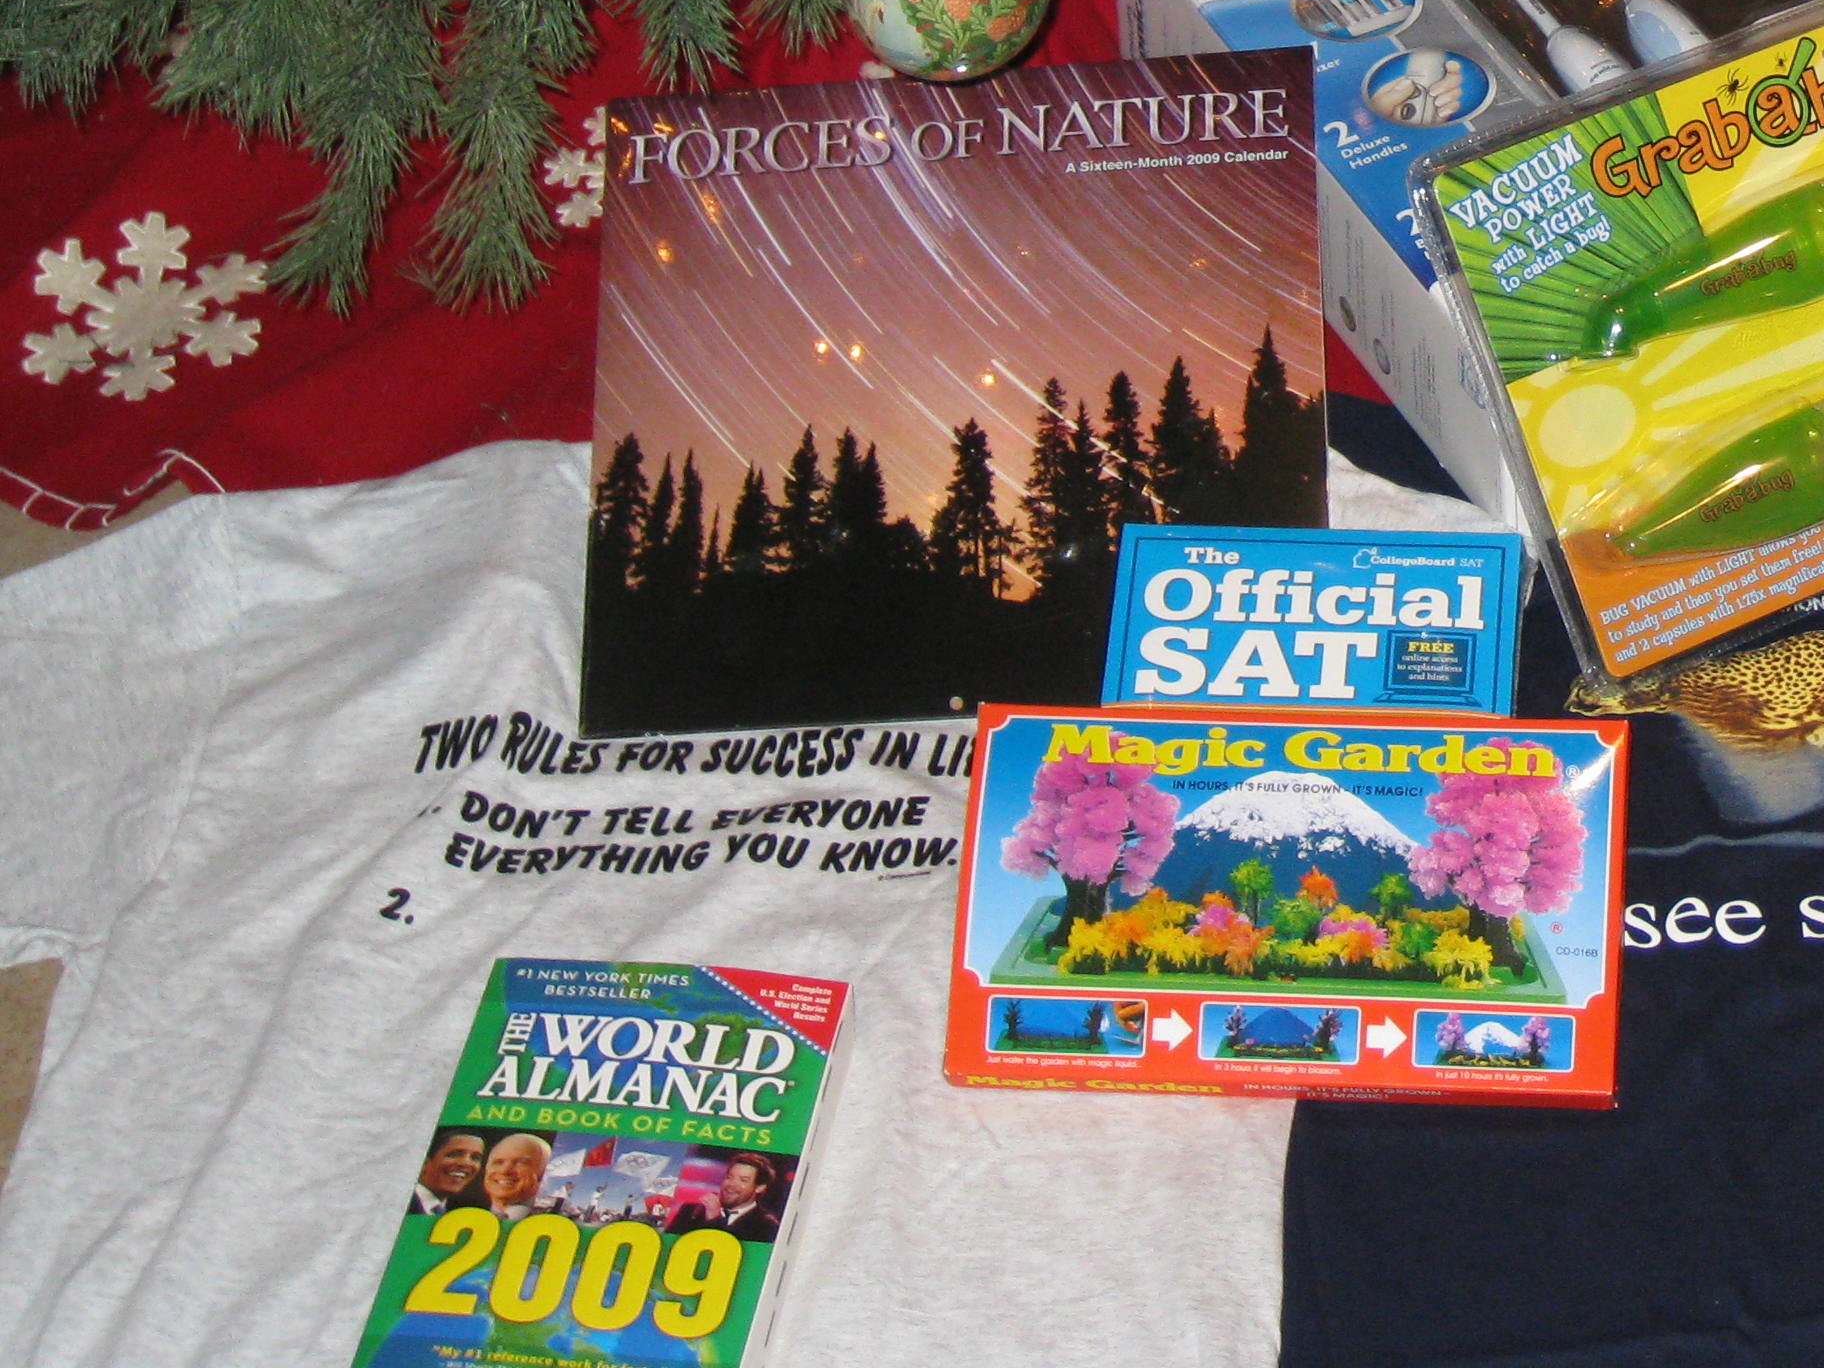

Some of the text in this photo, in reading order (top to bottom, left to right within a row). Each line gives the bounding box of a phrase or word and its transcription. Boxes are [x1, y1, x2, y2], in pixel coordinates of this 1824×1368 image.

[628, 87, 1291, 186] FORCES OF NATURE
[1323, 121, 1359, 148] 2
[1341, 134, 1391, 160] Deluxe
[1064, 148, 1289, 174] A Sixteen-Month 2009 Calendar
[1349, 142, 1408, 170] Handles
[1448, 132, 1586, 231] VACUUM
[1483, 170, 1577, 248] POWER
[1491, 245, 1527, 281] with
[1528, 189, 1598, 252] LIGHT
[1500, 215, 1614, 296] to catch a bug!
[1183, 546, 1485, 568] The CollegeBoard SAT
[1143, 568, 1485, 631] Official
[1600, 602, 1630, 625] BUG
[1631, 577, 1687, 612] VACUUM
[1688, 565, 1716, 586] with
[1716, 549, 1757, 577] LIGHT
[1607, 628, 1623, 644] to
[1626, 613, 1660, 638] study
[1661, 602, 1683, 621] and
[1714, 582, 1739, 602] you
[1740, 568, 1759, 587] set
[1760, 557, 1792, 578] them
[1791, 544, 1823, 565] free!
[1408, 641, 1455, 653] FREE
[1615, 643, 1639, 663] and
[1639, 638, 1651, 652] 2
[1652, 616, 1706, 645] capsules
[1706, 602, 1735, 622] with
[1133, 627, 1379, 700] SAT
[1402, 654, 1429, 662] online
[1408, 664, 1463, 673] explanations
[414, 714, 498, 774] TWO
[500, 710, 605, 775] RULES
[615, 739, 694, 773] FOR
[700, 728, 865, 778] SUCCESS
[868, 731, 918, 770] IN
[1041, 723, 1558, 778] Magic Garden
[1172, 781, 1185, 789] IN
[1188, 781, 1231, 792] HOURS,
[1235, 782, 1254, 792] IT'S
[1256, 783, 1288, 792] FULLY
[1292, 784, 1341, 794] GROWN
[1352, 786, 1373, 795] IT'S
[1374, 786, 1423, 797] MAGIC!
[460, 791, 591, 839] DON'T
[602, 806, 695, 837] TELL
[711, 796, 931, 831] EVERYONE
[445, 833, 959, 875] EVERYTHING YOU KNOW.
[378, 888, 414, 924] 2.
[1622, 895, 1767, 951] see
[515, 968, 691, 987] #1 NEW YORK TIMES
[544, 985, 652, 1000] BESTSELLER
[760, 989, 776, 998] U.S.
[779, 991, 813, 1002] Election
[792, 984, 832, 995] Complete
[774, 1000, 828, 1013] World Series
[793, 1012, 826, 1022] Results
[497, 1012, 797, 1075] THE WORLD
[476, 1056, 788, 1123] ALMANAC
[966, 1074, 1223, 1093] Magic Garden
[466, 1104, 772, 1146] AND BOOK OF FACTS
[403, 1206, 743, 1339] 2009
